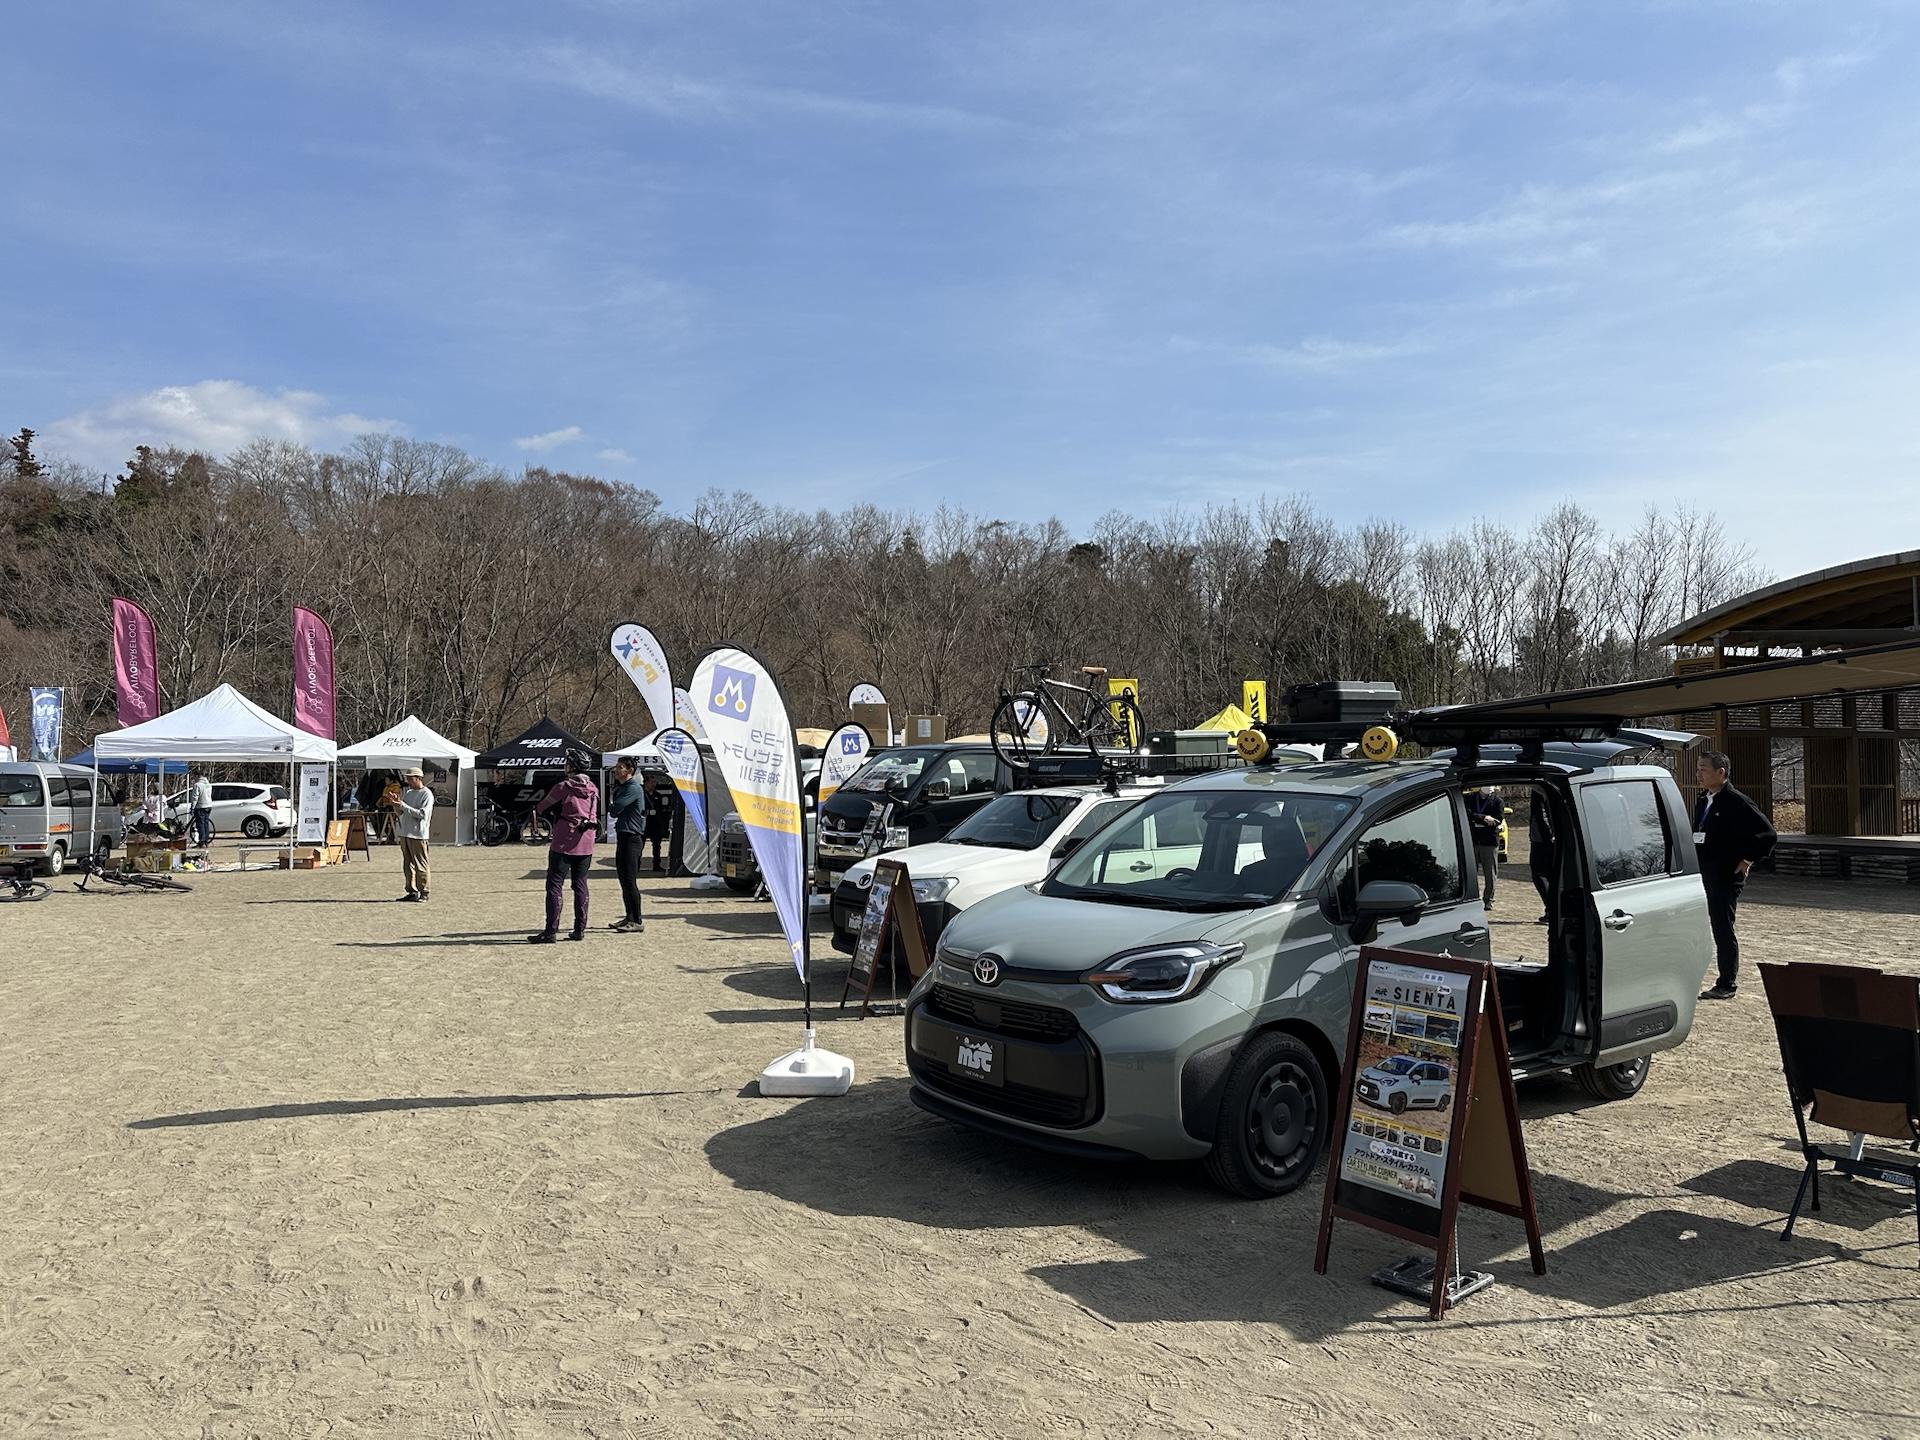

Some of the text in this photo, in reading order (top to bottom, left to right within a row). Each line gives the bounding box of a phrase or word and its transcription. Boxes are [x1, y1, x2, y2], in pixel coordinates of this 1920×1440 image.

[497, 757, 567, 766] SANTA CRU
[1393, 986, 1456, 1010] SIENTA
